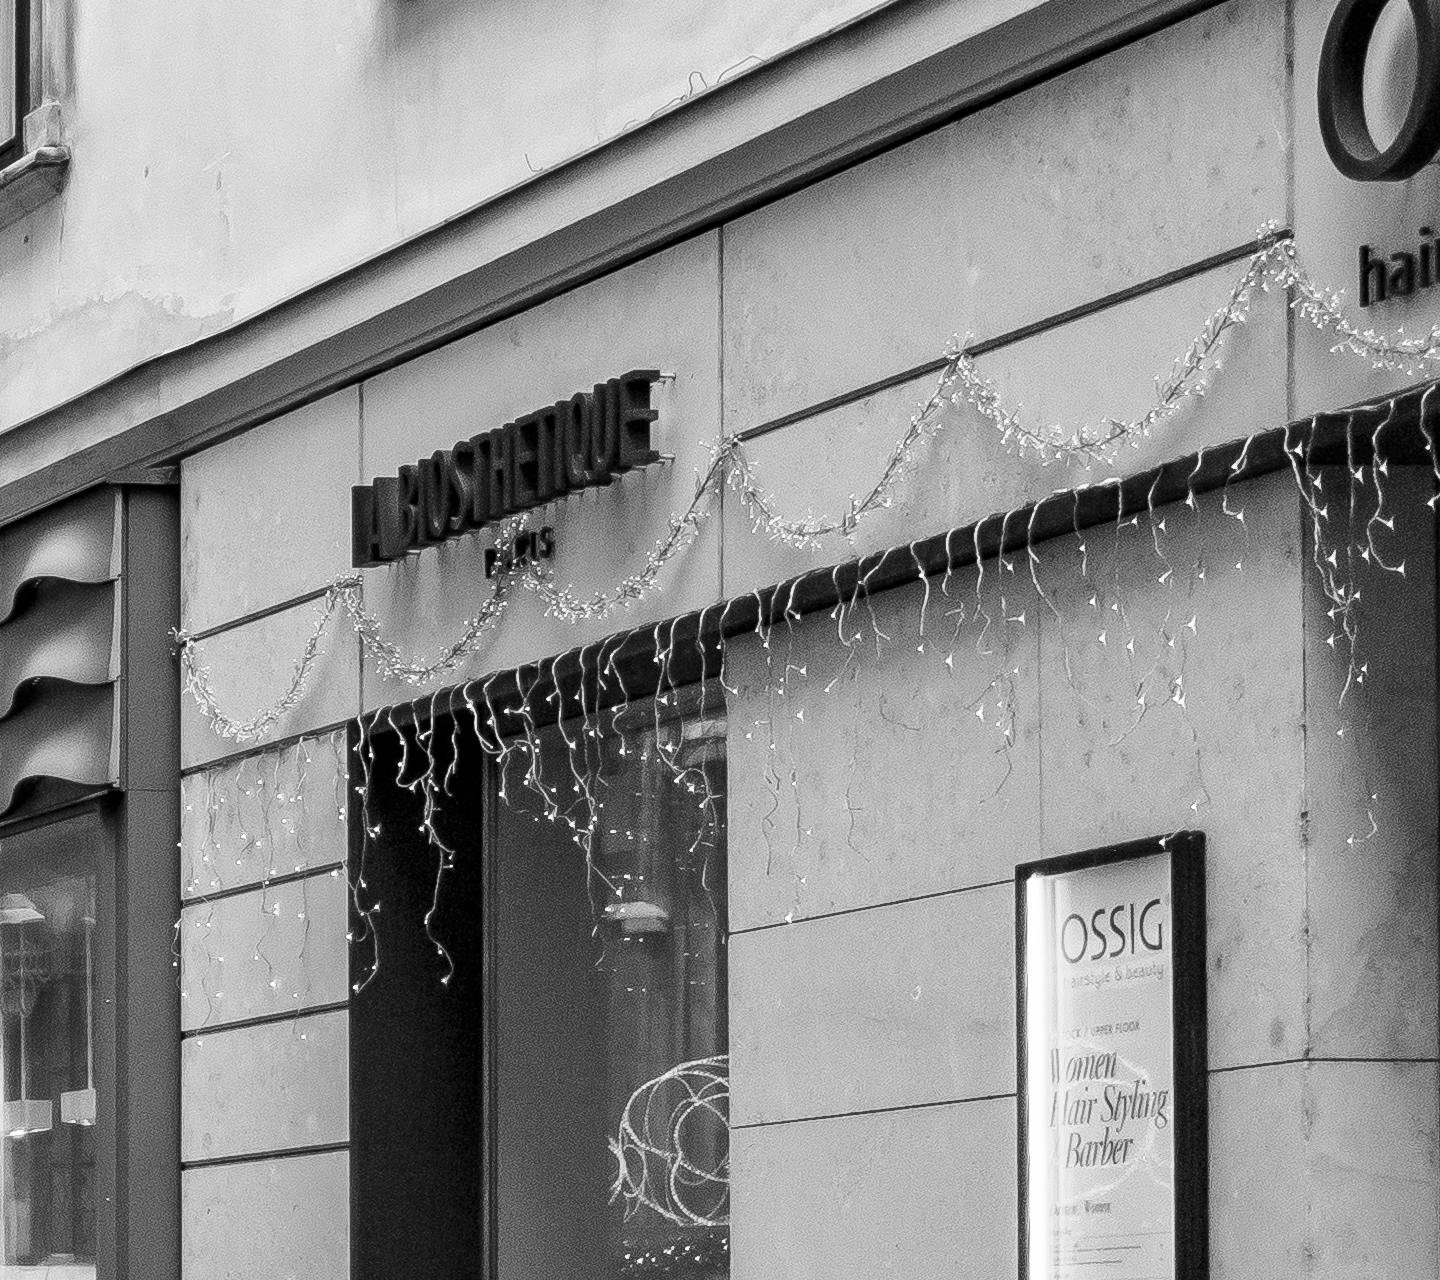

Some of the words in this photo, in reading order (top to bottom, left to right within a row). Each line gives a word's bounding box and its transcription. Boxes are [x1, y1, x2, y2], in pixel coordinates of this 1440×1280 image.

[1062, 898, 1162, 964] OSSIG
[1126, 961, 1164, 981] beauty
[1100, 1079, 1169, 1133] Styling
[1065, 1126, 1134, 1169] Barber
